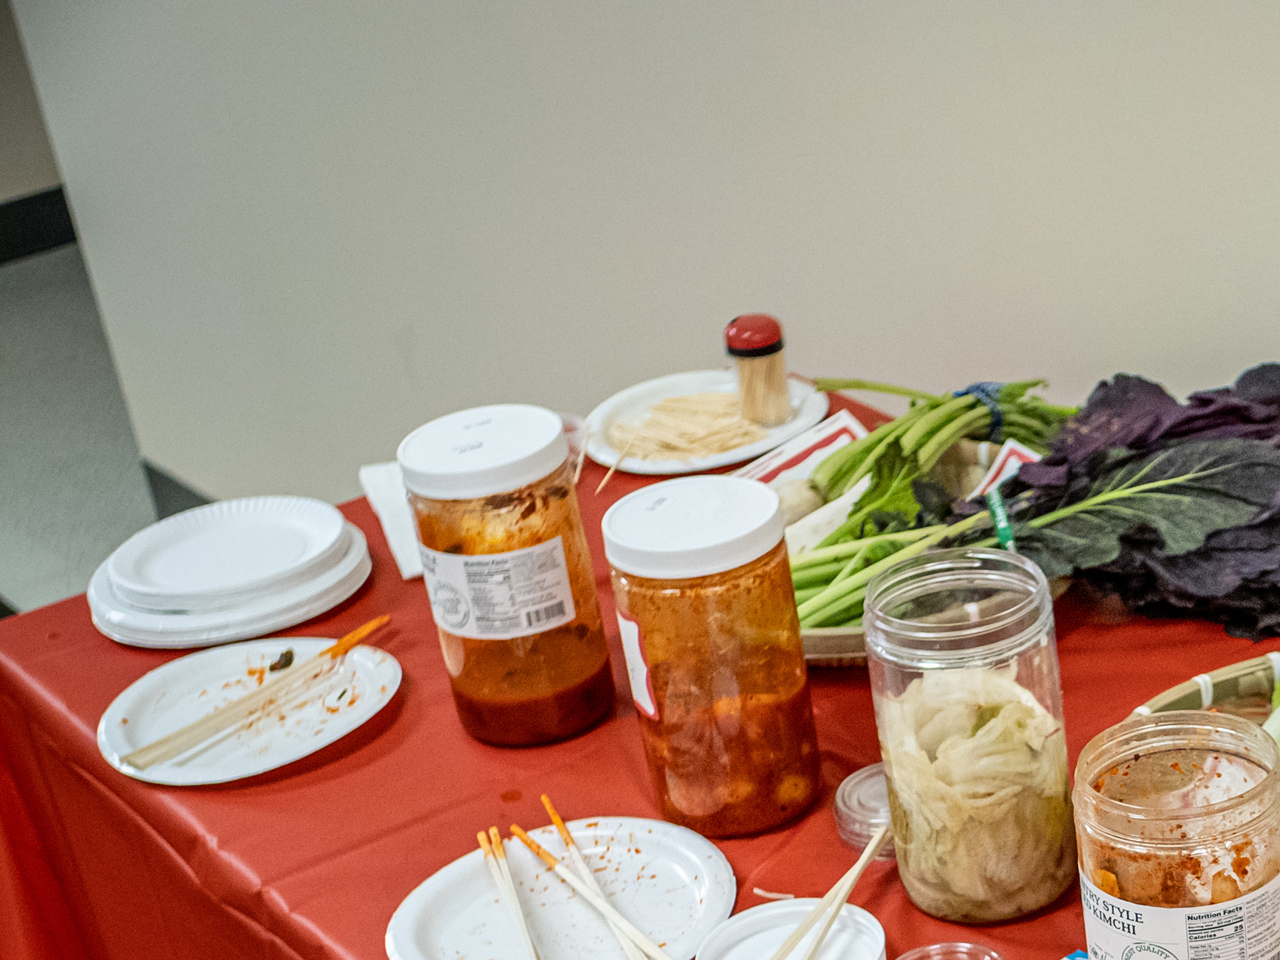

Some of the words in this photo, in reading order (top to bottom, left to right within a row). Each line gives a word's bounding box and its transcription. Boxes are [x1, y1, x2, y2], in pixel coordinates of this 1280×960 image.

[1102, 900, 1144, 924] STYLE
[1187, 911, 1222, 921] Nutrition
[1223, 905, 1243, 916] Facts
[1092, 905, 1137, 935] KIMCHI
[1233, 923, 1244, 932] 25
[1188, 933, 1217, 941] Calories
[1135, 945, 1171, 960] QUALITY
